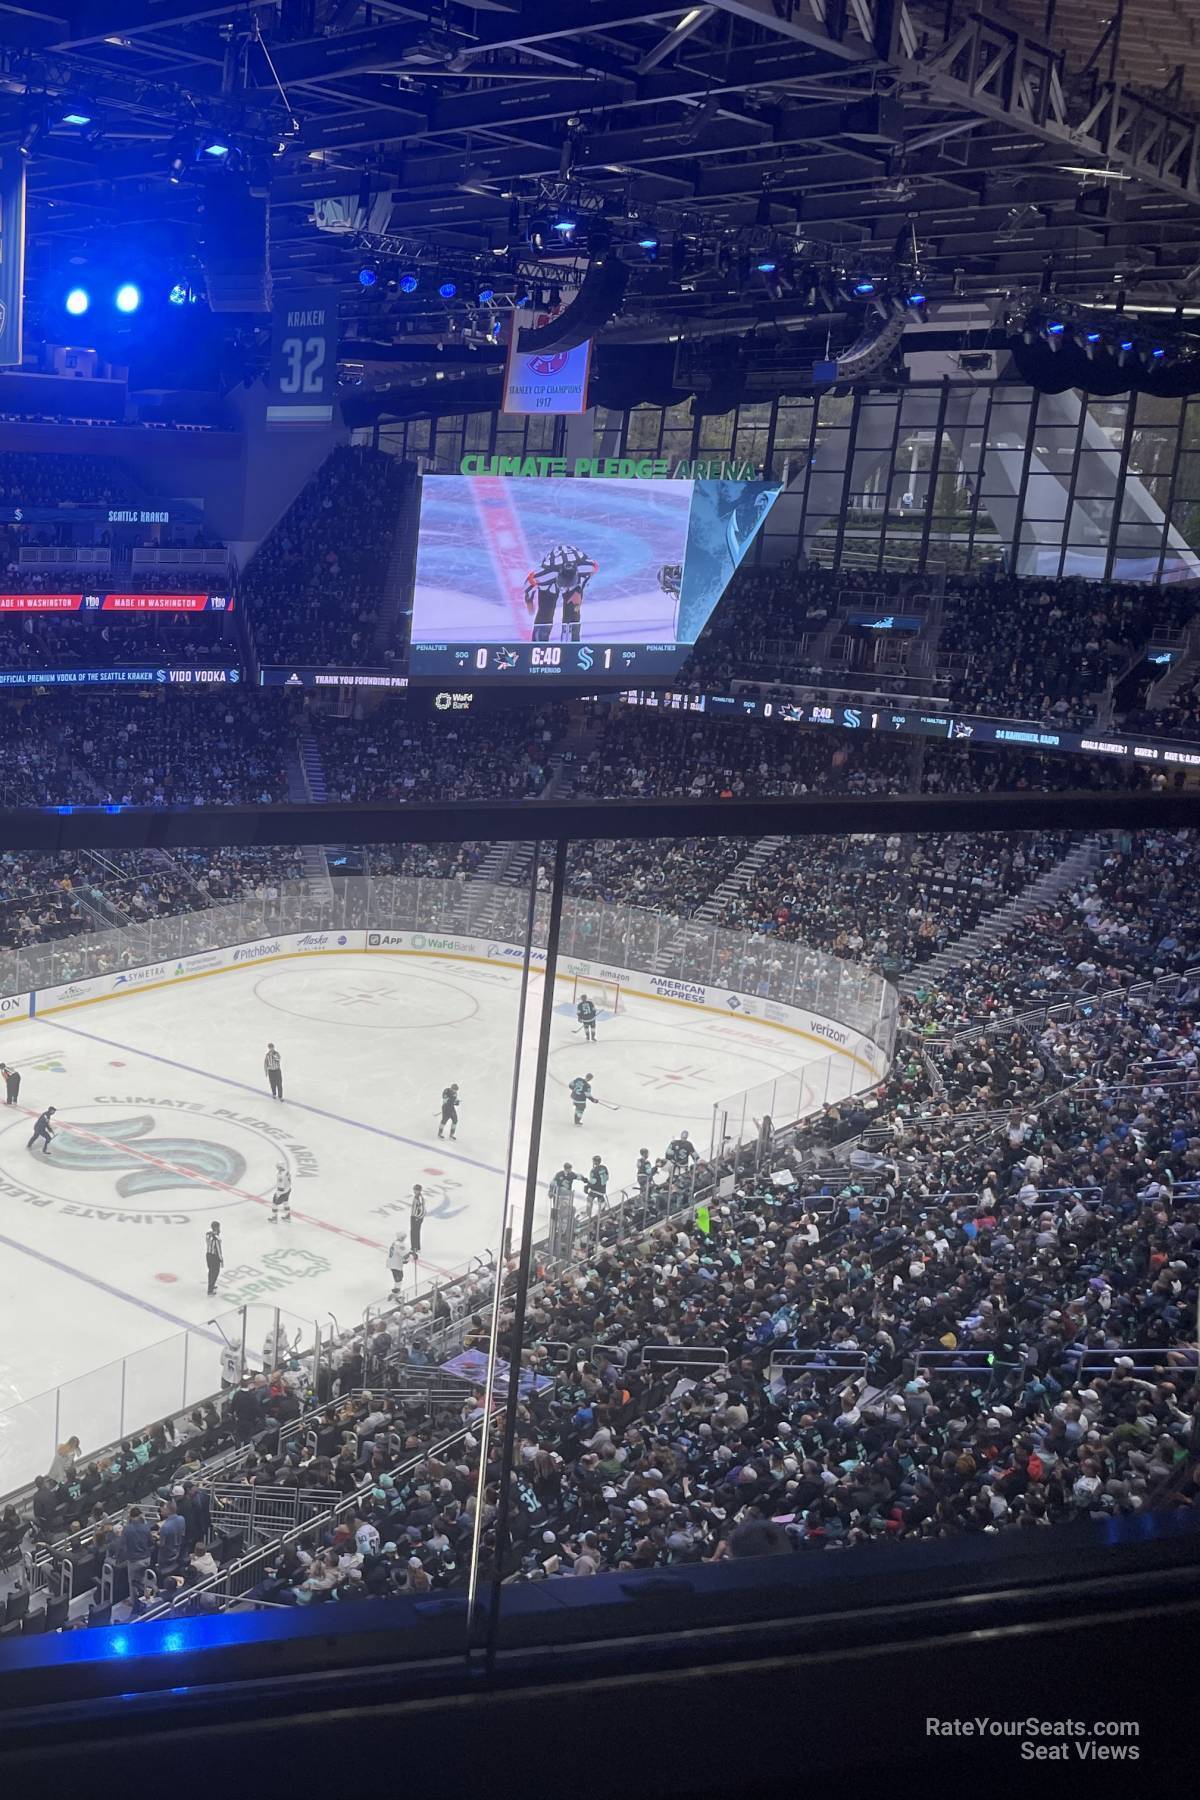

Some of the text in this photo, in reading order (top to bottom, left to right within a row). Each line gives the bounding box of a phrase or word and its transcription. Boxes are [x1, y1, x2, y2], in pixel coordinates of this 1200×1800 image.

[287, 310, 325, 328] KRAKEN
[280, 337, 326, 393] 32
[533, 385, 546, 394] CUP
[546, 384, 582, 394] CHAMPIONS
[460, 456, 757, 480] CLIMATE PLEDGE ARENA
[108, 510, 169, 522] SEATTLE KRAKEN
[17, 599, 24, 607] IN
[27, 598, 72, 607] WASHINGTON
[114, 599, 135, 607] MADE
[147, 598, 197, 607] WASHINGTON
[476, 648, 488, 669] 0
[531, 647, 561, 665] 6:40
[604, 648, 612, 669] 1
[622, 651, 636, 659] SOG
[625, 659, 631, 667] 7
[0, 672, 153, 683] OFFICIAL PREMIUM VODKA OF THE SEATTLE KRAKEN
[169, 670, 226, 682] VIDO VODKA
[315, 675, 339, 684] THANK
[340, 675, 354, 684] YOU
[354, 676, 391, 686] FOUNDING
[452, 693, 473, 702] WaFd
[764, 703, 772, 717] 0
[871, 713, 878, 728] 1
[297, 934, 329, 946] Alaska
[428, 938, 476, 952] WaFd Bank
[240, 941, 281, 960] PitchBook
[128, 968, 165, 981] SYMETRA
[600, 970, 630, 981] amazon
[650, 977, 706, 995] AMERICAN
[656, 987, 705, 1004] EXPRESS
[810, 1020, 846, 1044] verizon
[94, 1096, 321, 1178] CLIMATE PLEDGE ARENA
[61, 1204, 192, 1225] CLIMATE
[220, 1275, 295, 1306] WaFd
